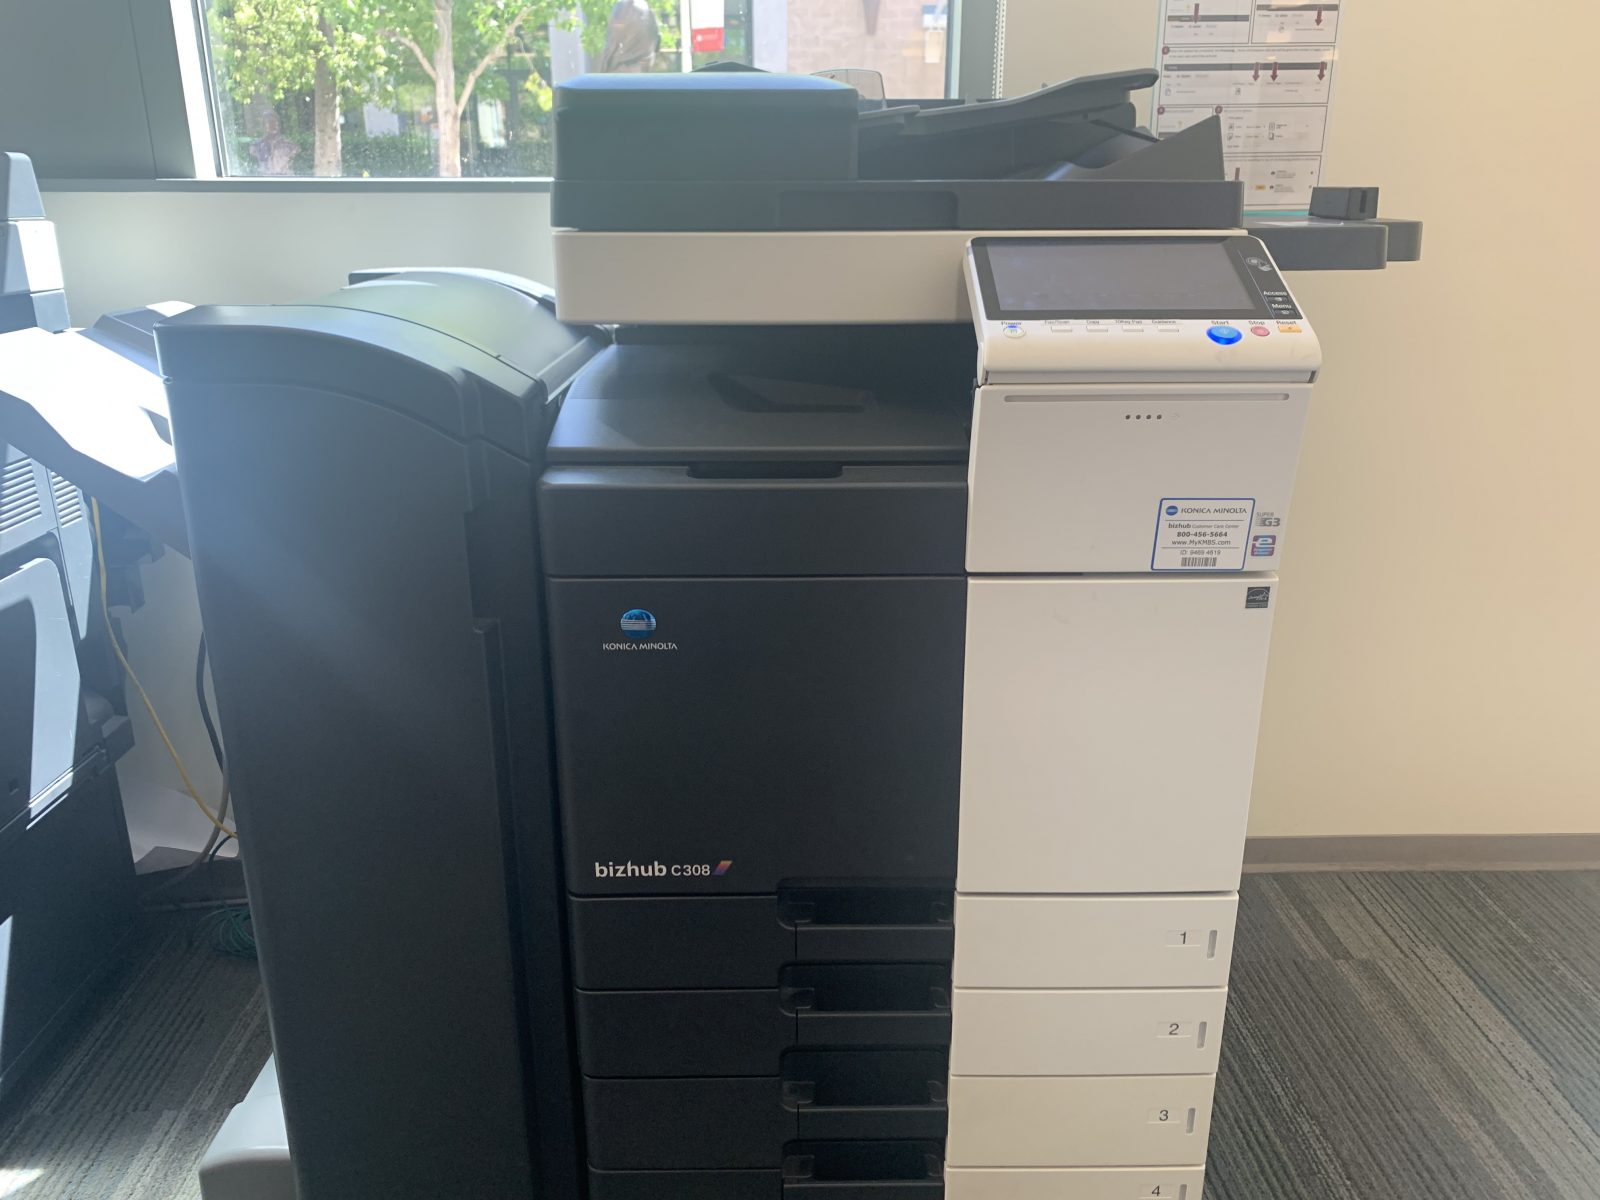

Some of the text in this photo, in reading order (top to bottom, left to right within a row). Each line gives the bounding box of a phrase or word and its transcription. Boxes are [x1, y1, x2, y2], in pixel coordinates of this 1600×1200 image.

[602, 642, 678, 650] KONICA MINOLTA
[594, 860, 711, 878] bizhub C308
[1180, 931, 1187, 945] 1
[1168, 1023, 1180, 1036] 2
[1158, 1109, 1169, 1122] 3
[1151, 1185, 1161, 1197] 4
